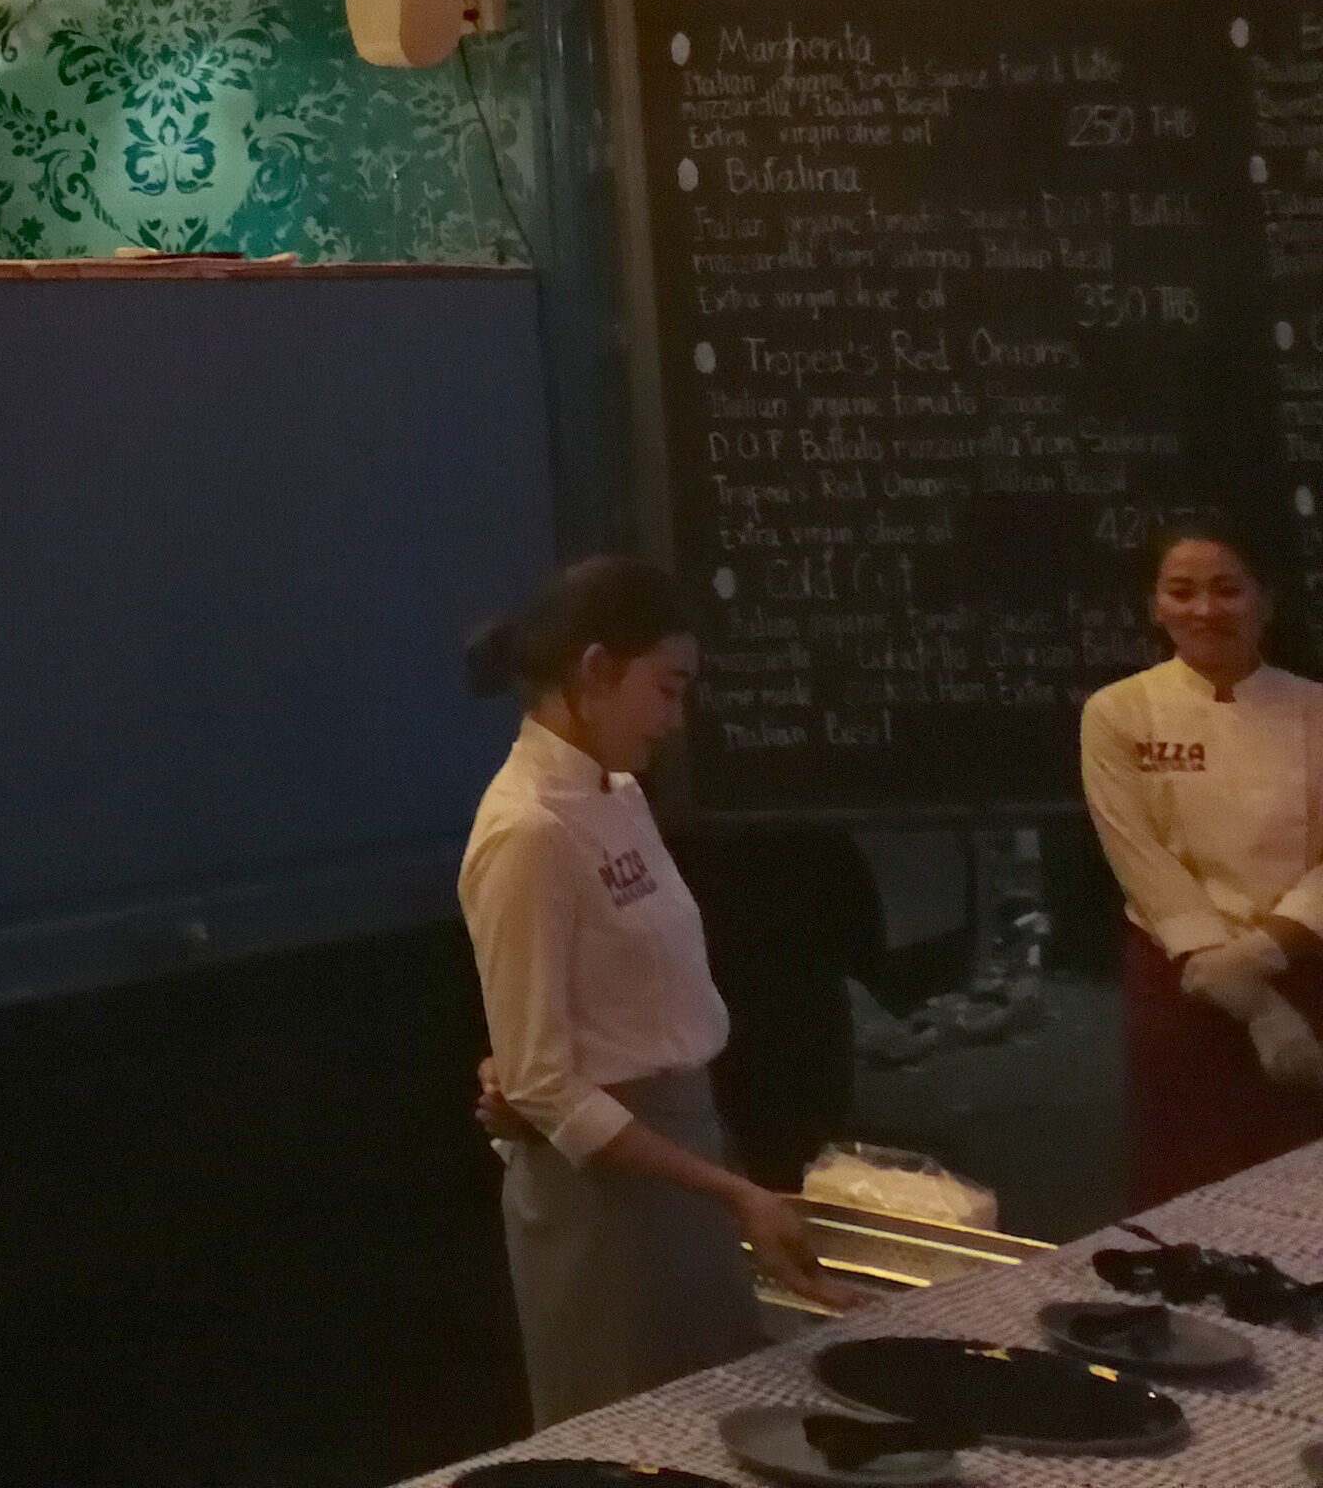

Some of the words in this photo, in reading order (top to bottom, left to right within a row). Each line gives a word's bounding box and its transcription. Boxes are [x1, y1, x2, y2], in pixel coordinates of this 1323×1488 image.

[1067, 104, 1137, 147] 250
[725, 154, 863, 195] Bufalina
[1074, 281, 1149, 328] 350
[890, 327, 952, 372] Red
